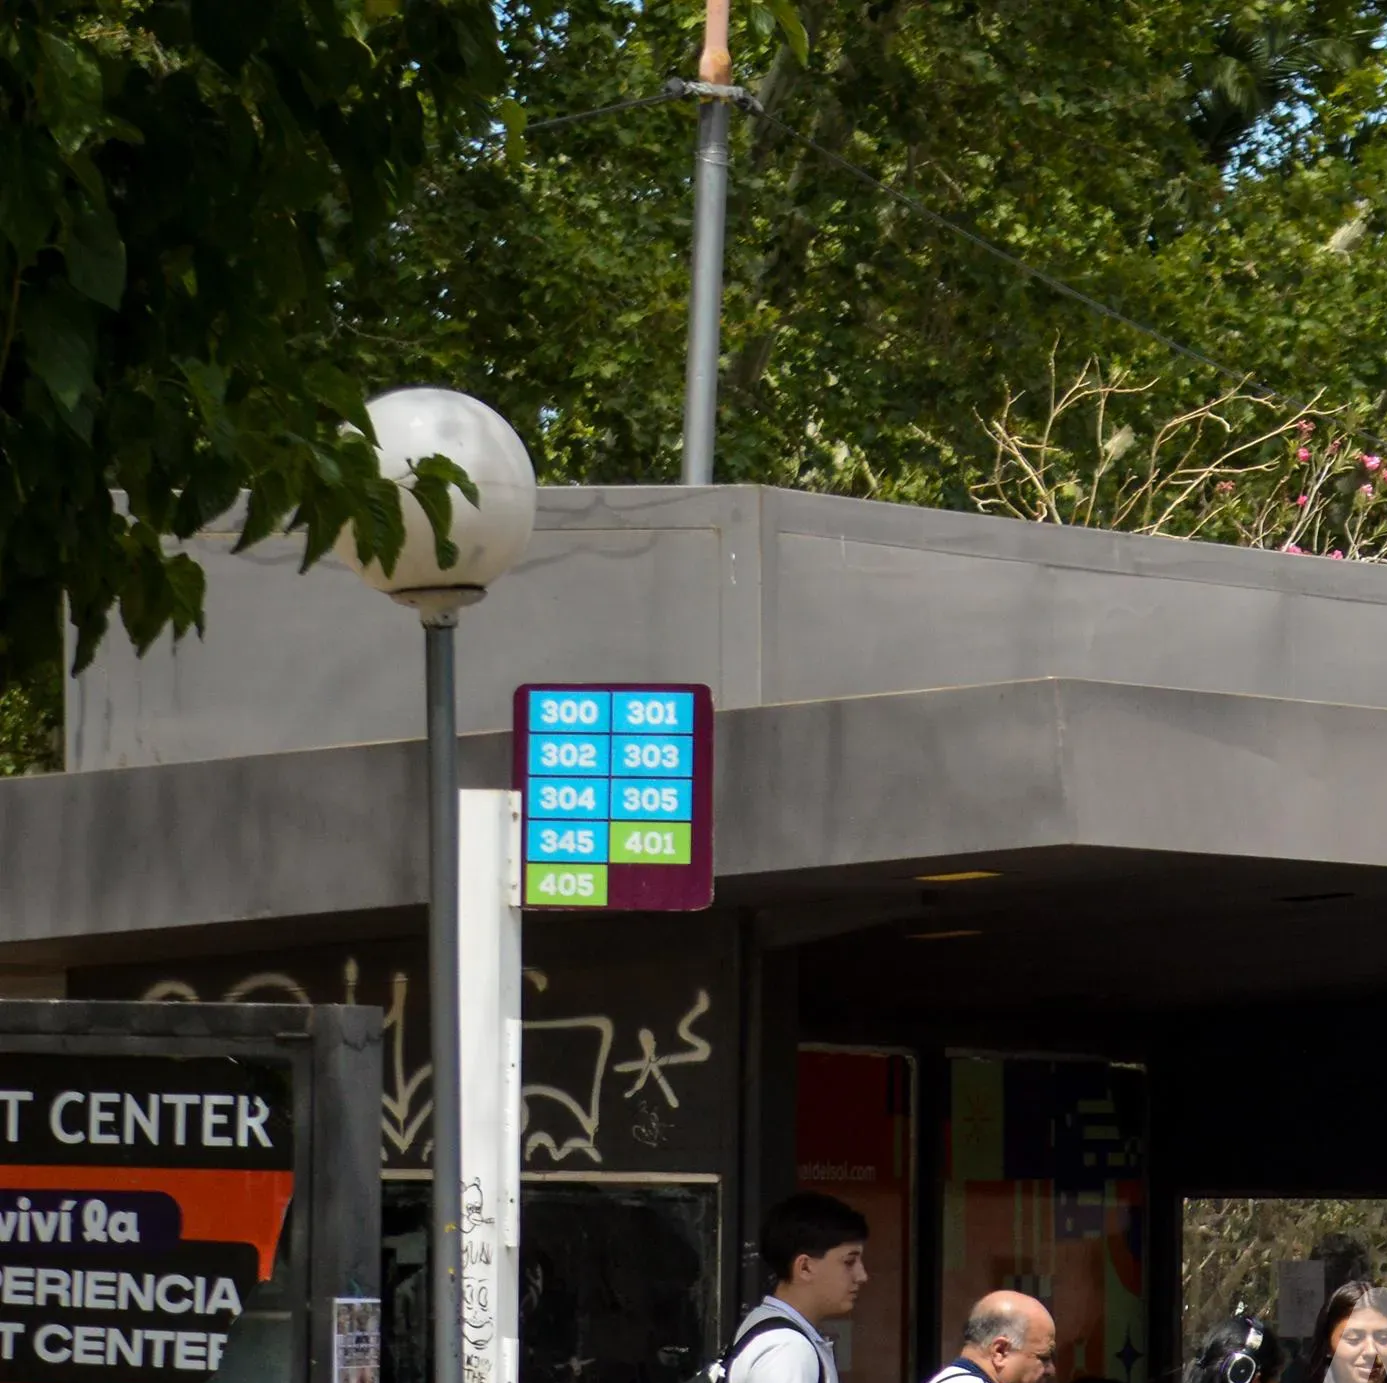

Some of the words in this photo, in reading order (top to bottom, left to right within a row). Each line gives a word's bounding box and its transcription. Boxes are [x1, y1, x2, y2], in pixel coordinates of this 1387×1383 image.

[541, 700, 597, 724] 300
[627, 700, 678, 725] 301
[541, 743, 597, 767] 302
[624, 744, 679, 768] 303
[540, 786, 596, 811] 304
[623, 787, 679, 812] 305
[540, 830, 594, 853] 345
[624, 832, 676, 855] 401
[538, 873, 595, 896] 405
[49, 1091, 274, 1147] CENTER
[82, 1199, 141, 1243] la
[0, 1266, 243, 1316] ERIENCIA
